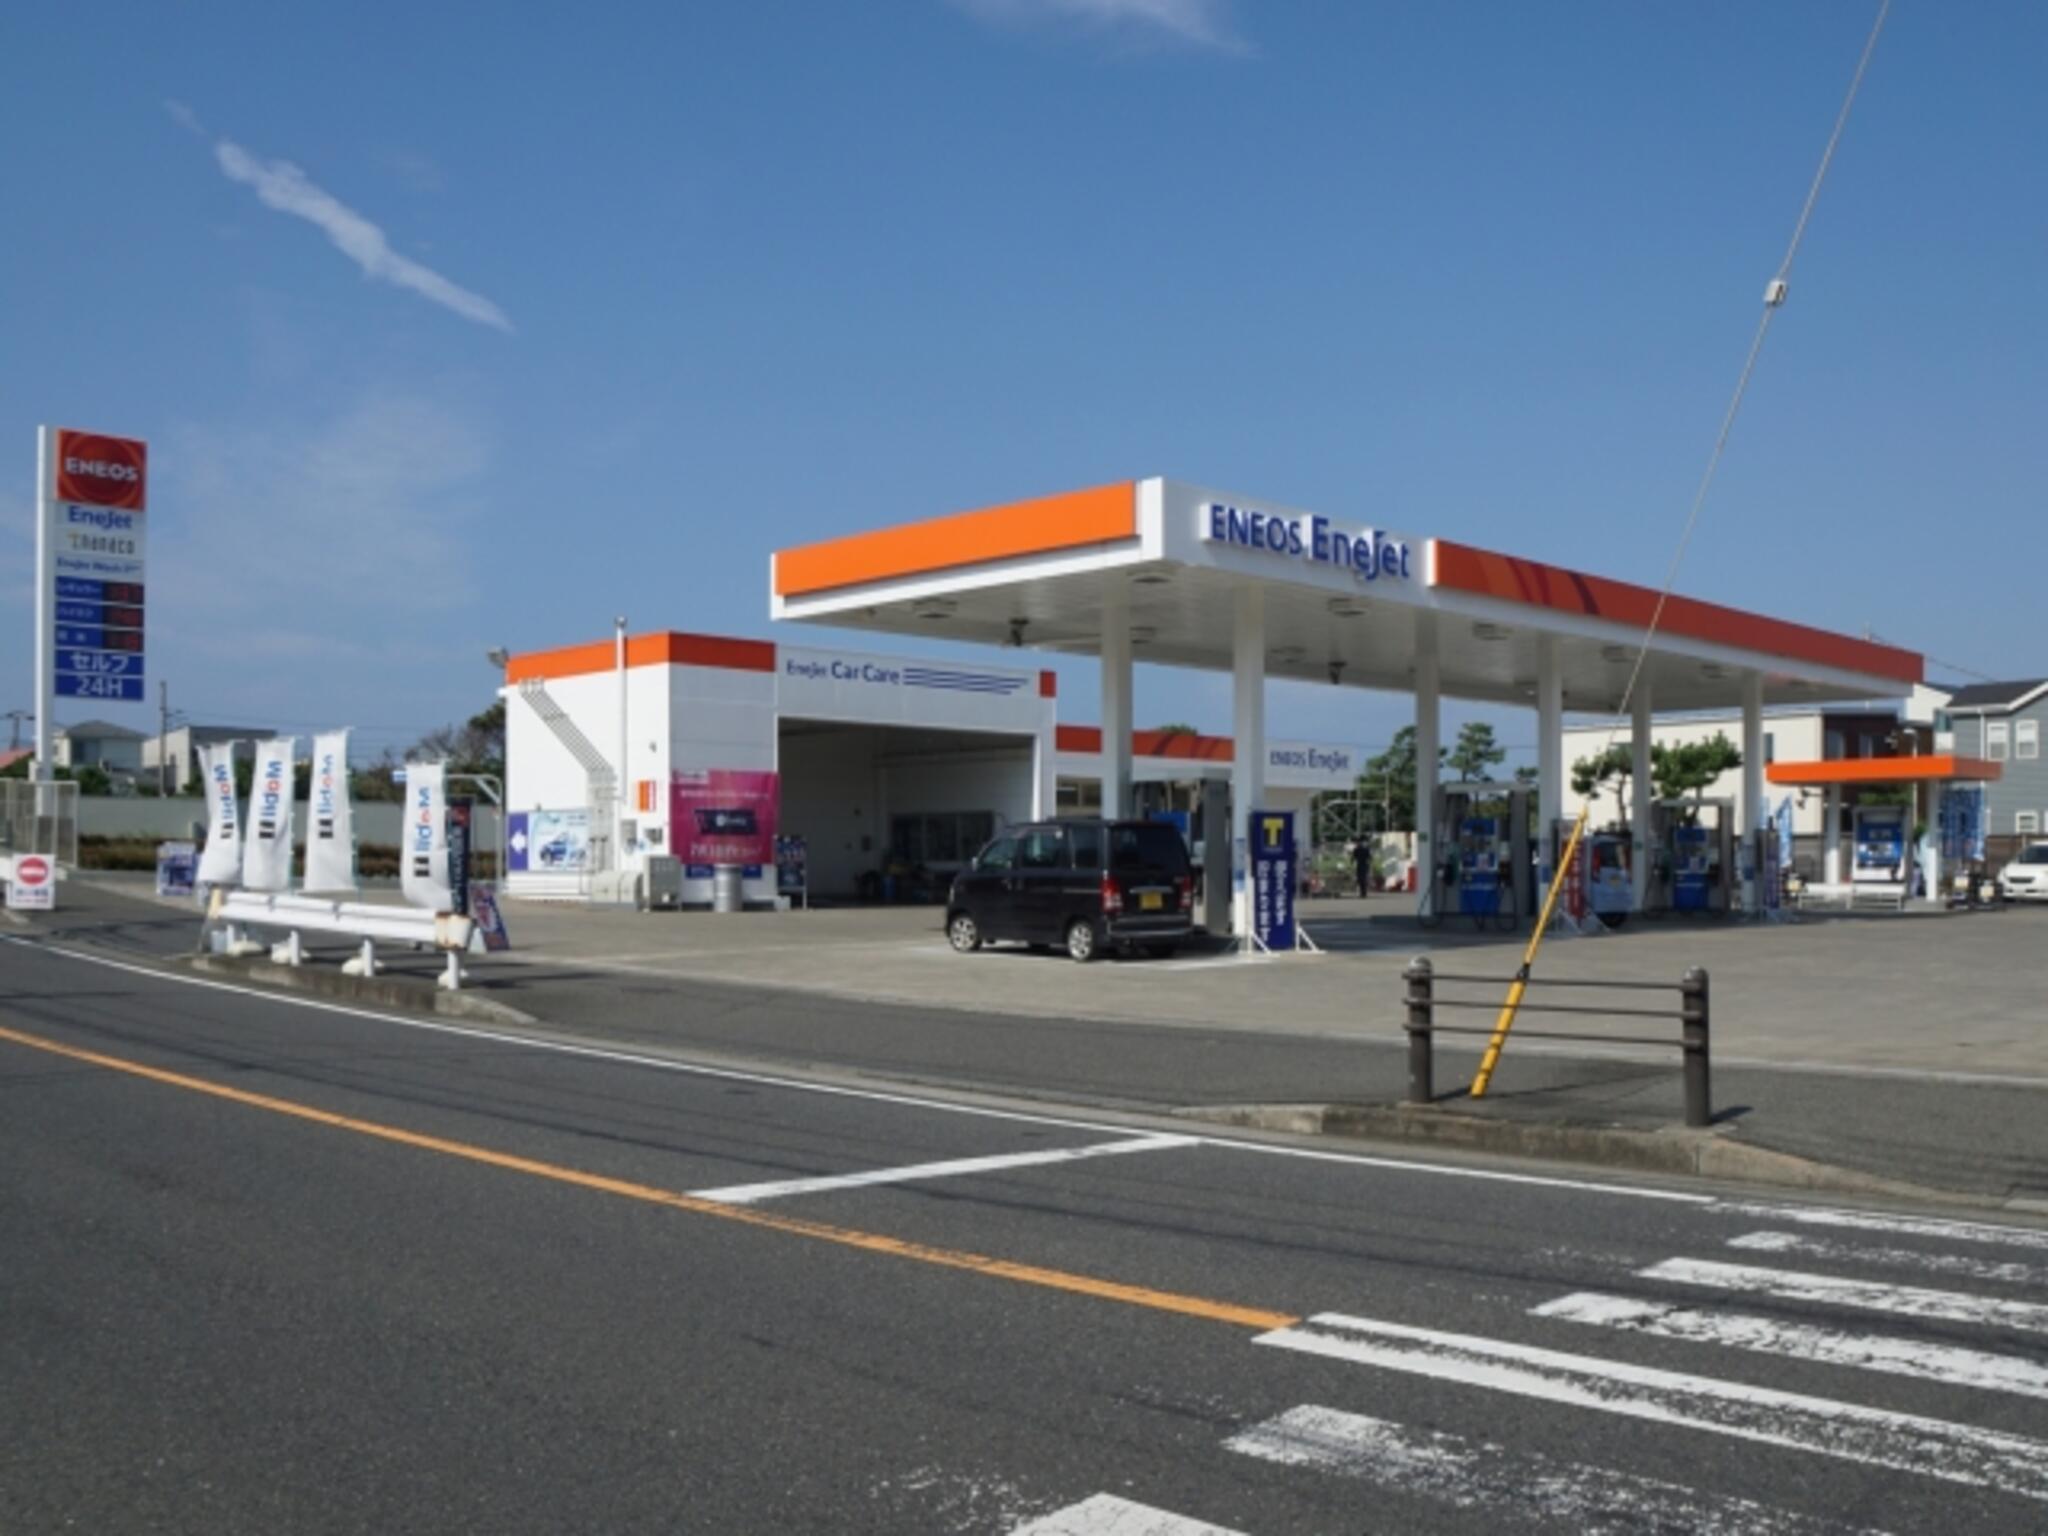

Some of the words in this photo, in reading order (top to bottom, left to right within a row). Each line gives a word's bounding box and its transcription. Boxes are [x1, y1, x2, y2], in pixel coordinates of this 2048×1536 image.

[65, 457, 138, 482] ENEOS
[1211, 504, 1302, 555] ENEOS
[70, 652, 129, 673] セルフ
[831, 659, 859, 680] Car
[862, 664, 899, 685] Care
[76, 677, 123, 696] 24H
[1263, 818, 1284, 846] T
